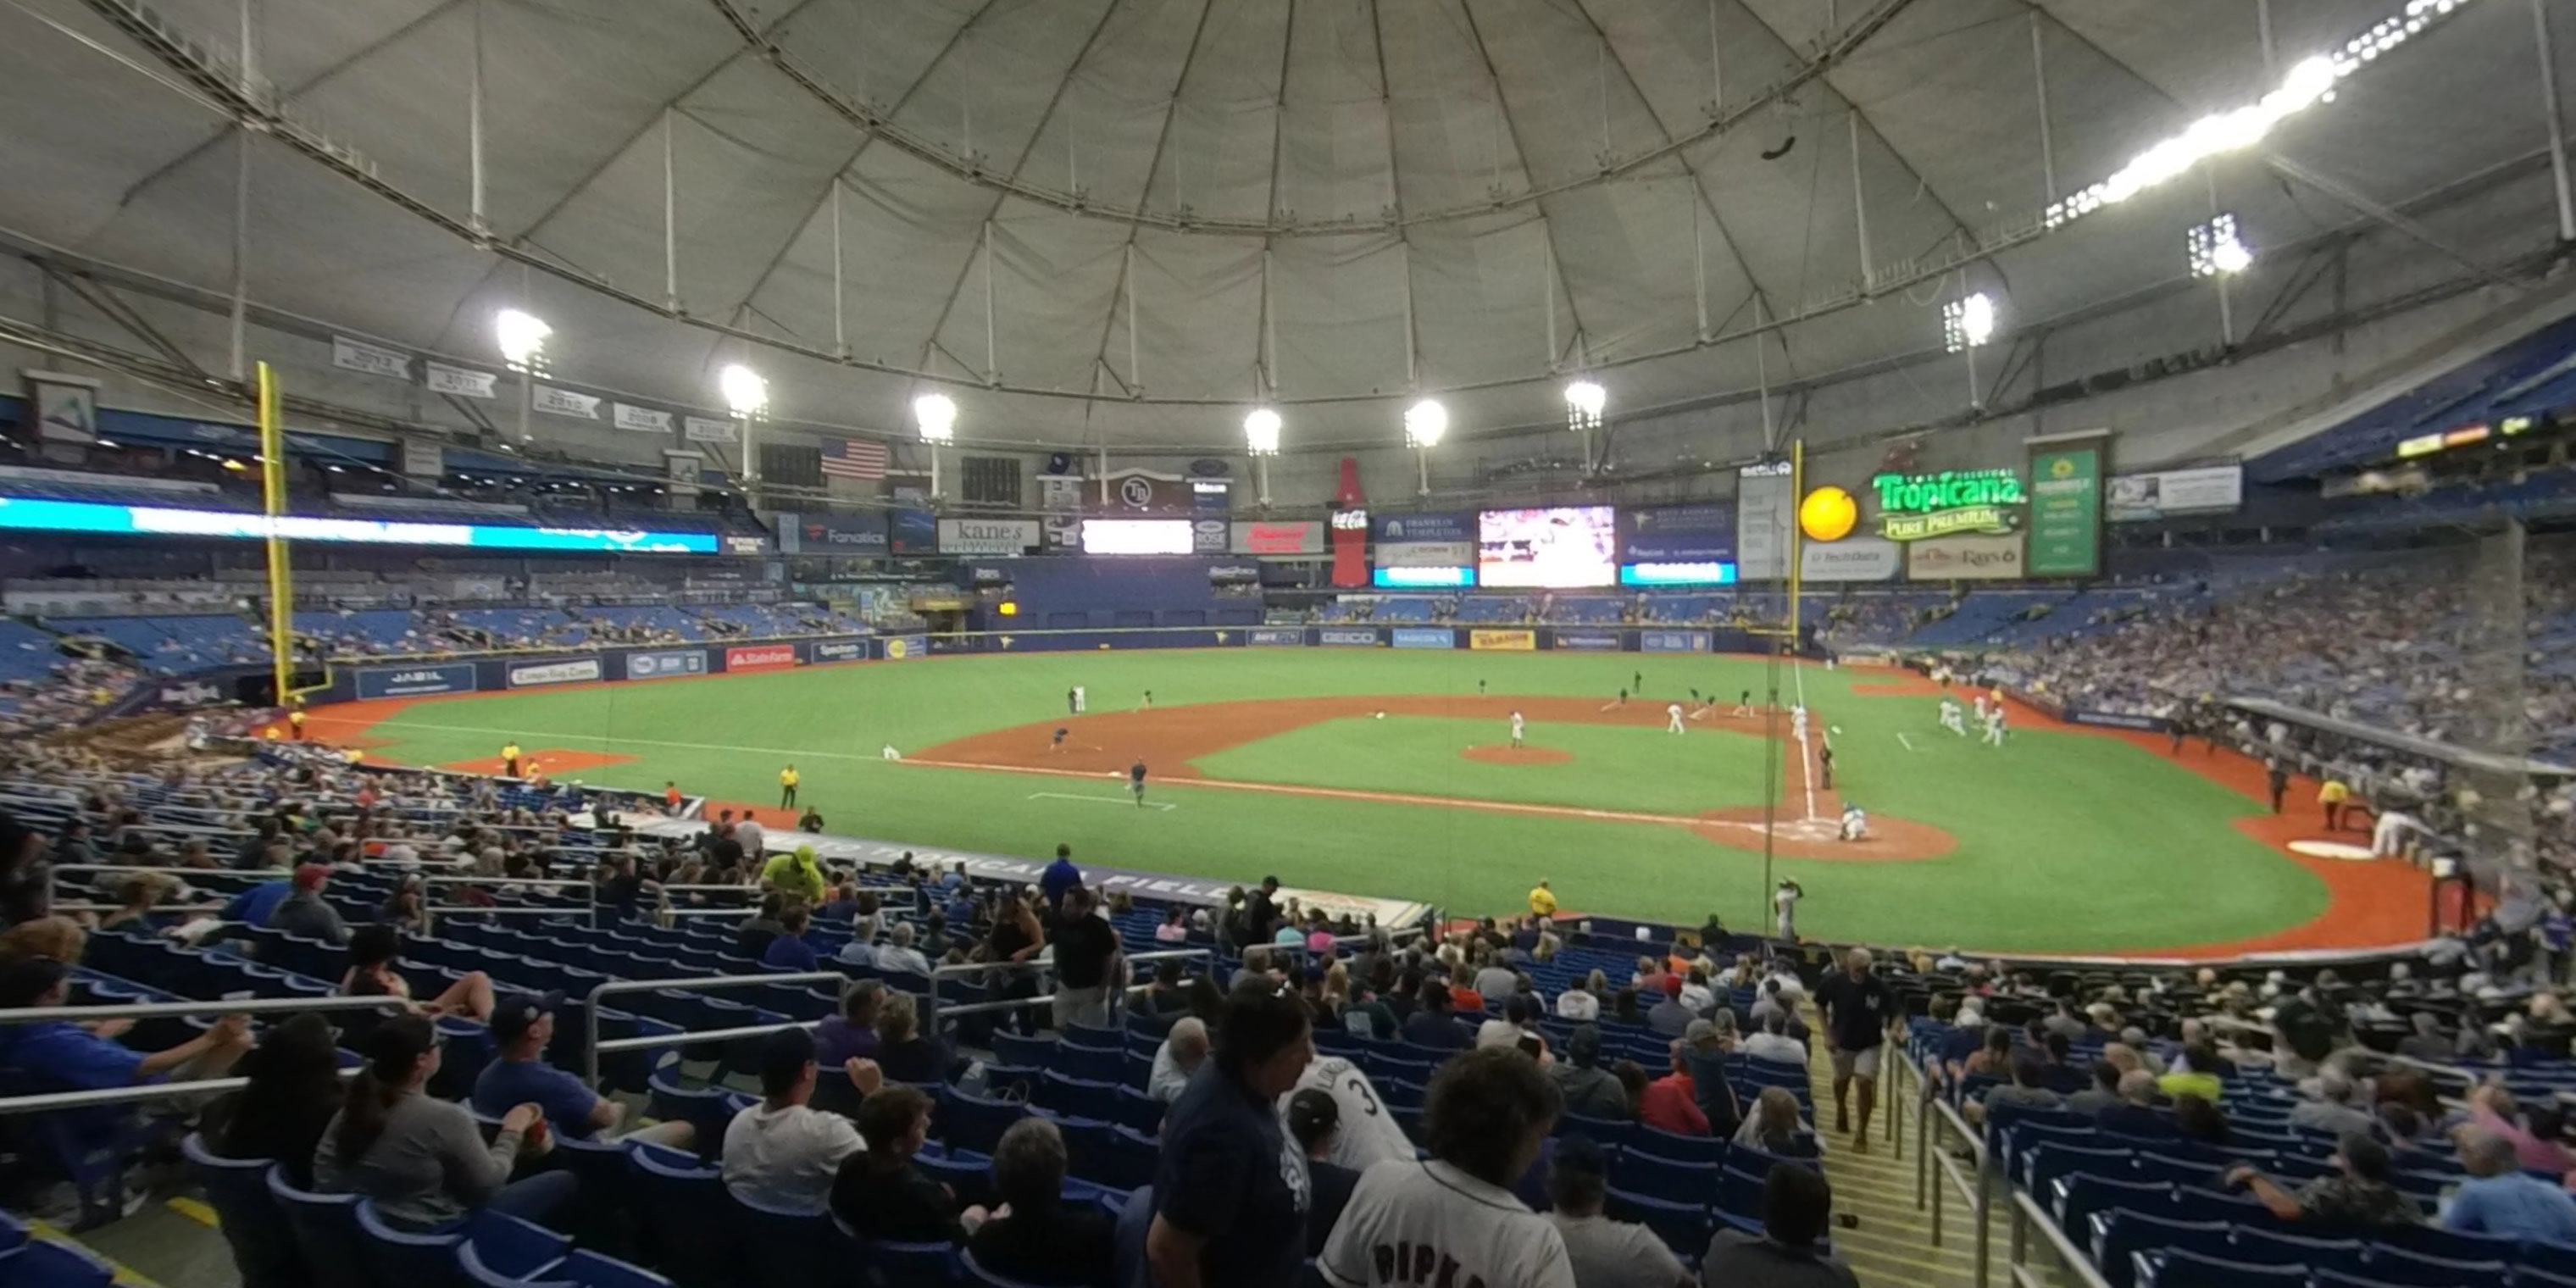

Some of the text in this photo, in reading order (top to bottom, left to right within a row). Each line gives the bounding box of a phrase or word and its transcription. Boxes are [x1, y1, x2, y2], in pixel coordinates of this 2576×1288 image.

[1873, 471, 2022, 514] Tropicana
[1886, 510, 2000, 536] PURE PREMIUM
[828, 529, 886, 544] Fanatics
[1321, 631, 1375, 644] GEICO
[1347, 1079, 1378, 1116] 3
